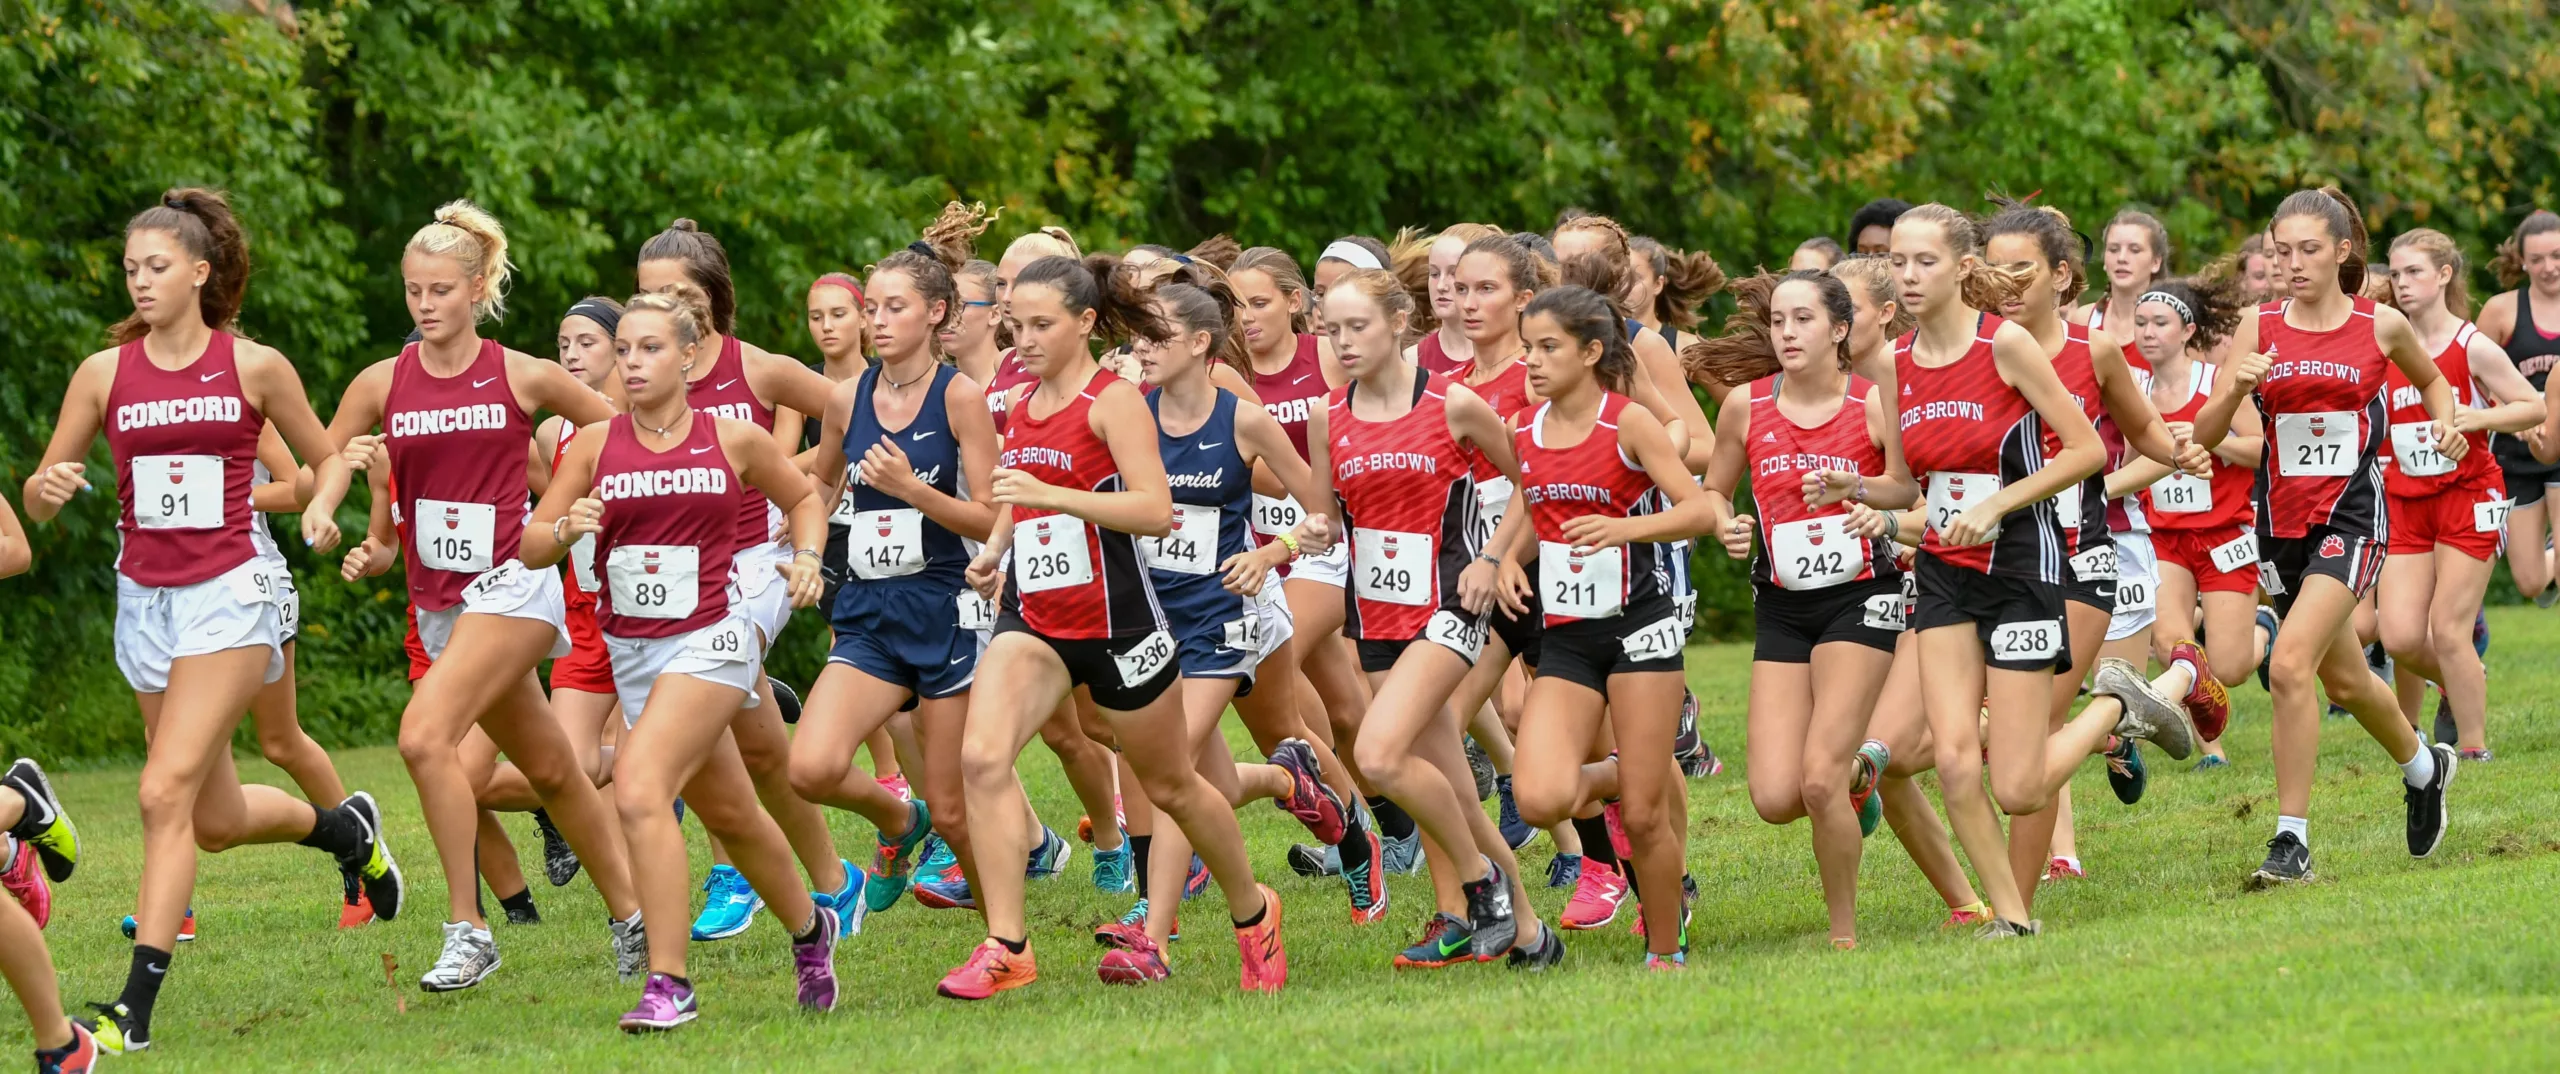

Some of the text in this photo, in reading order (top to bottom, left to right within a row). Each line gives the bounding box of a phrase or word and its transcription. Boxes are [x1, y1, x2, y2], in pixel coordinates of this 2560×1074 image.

[2265, 360, 2361, 385] COE-BROWN
[117, 396, 242, 432] CONCORD
[391, 403, 507, 438] CONCORD
[1900, 400, 1984, 432] COE-BROWN
[1338, 452, 1437, 481] COE-BROWN
[2297, 443, 2341, 466] 217
[2409, 449, 2440, 467] 171
[600, 467, 727, 502] CONCORD
[2162, 485, 2195, 504] 181
[161, 493, 189, 516] 91
[1258, 505, 1297, 527] 199
[432, 537, 472, 562] 105
[864, 545, 905, 568] 147
[1153, 538, 1197, 563] 144
[2223, 538, 2255, 564] 181
[1027, 551, 1070, 580] 236
[1795, 551, 1844, 579] 242
[253, 573, 273, 595] 91
[1370, 565, 1411, 592] 249
[635, 583, 667, 606] 89
[1555, 580, 1596, 606] 211
[2119, 583, 2145, 605] 00
[972, 599, 996, 622] 14
[711, 630, 739, 653] 89
[1442, 618, 1479, 651] 249
[1639, 624, 1679, 653] 211
[2004, 628, 2049, 653] 238
[1131, 636, 1169, 676] 236
